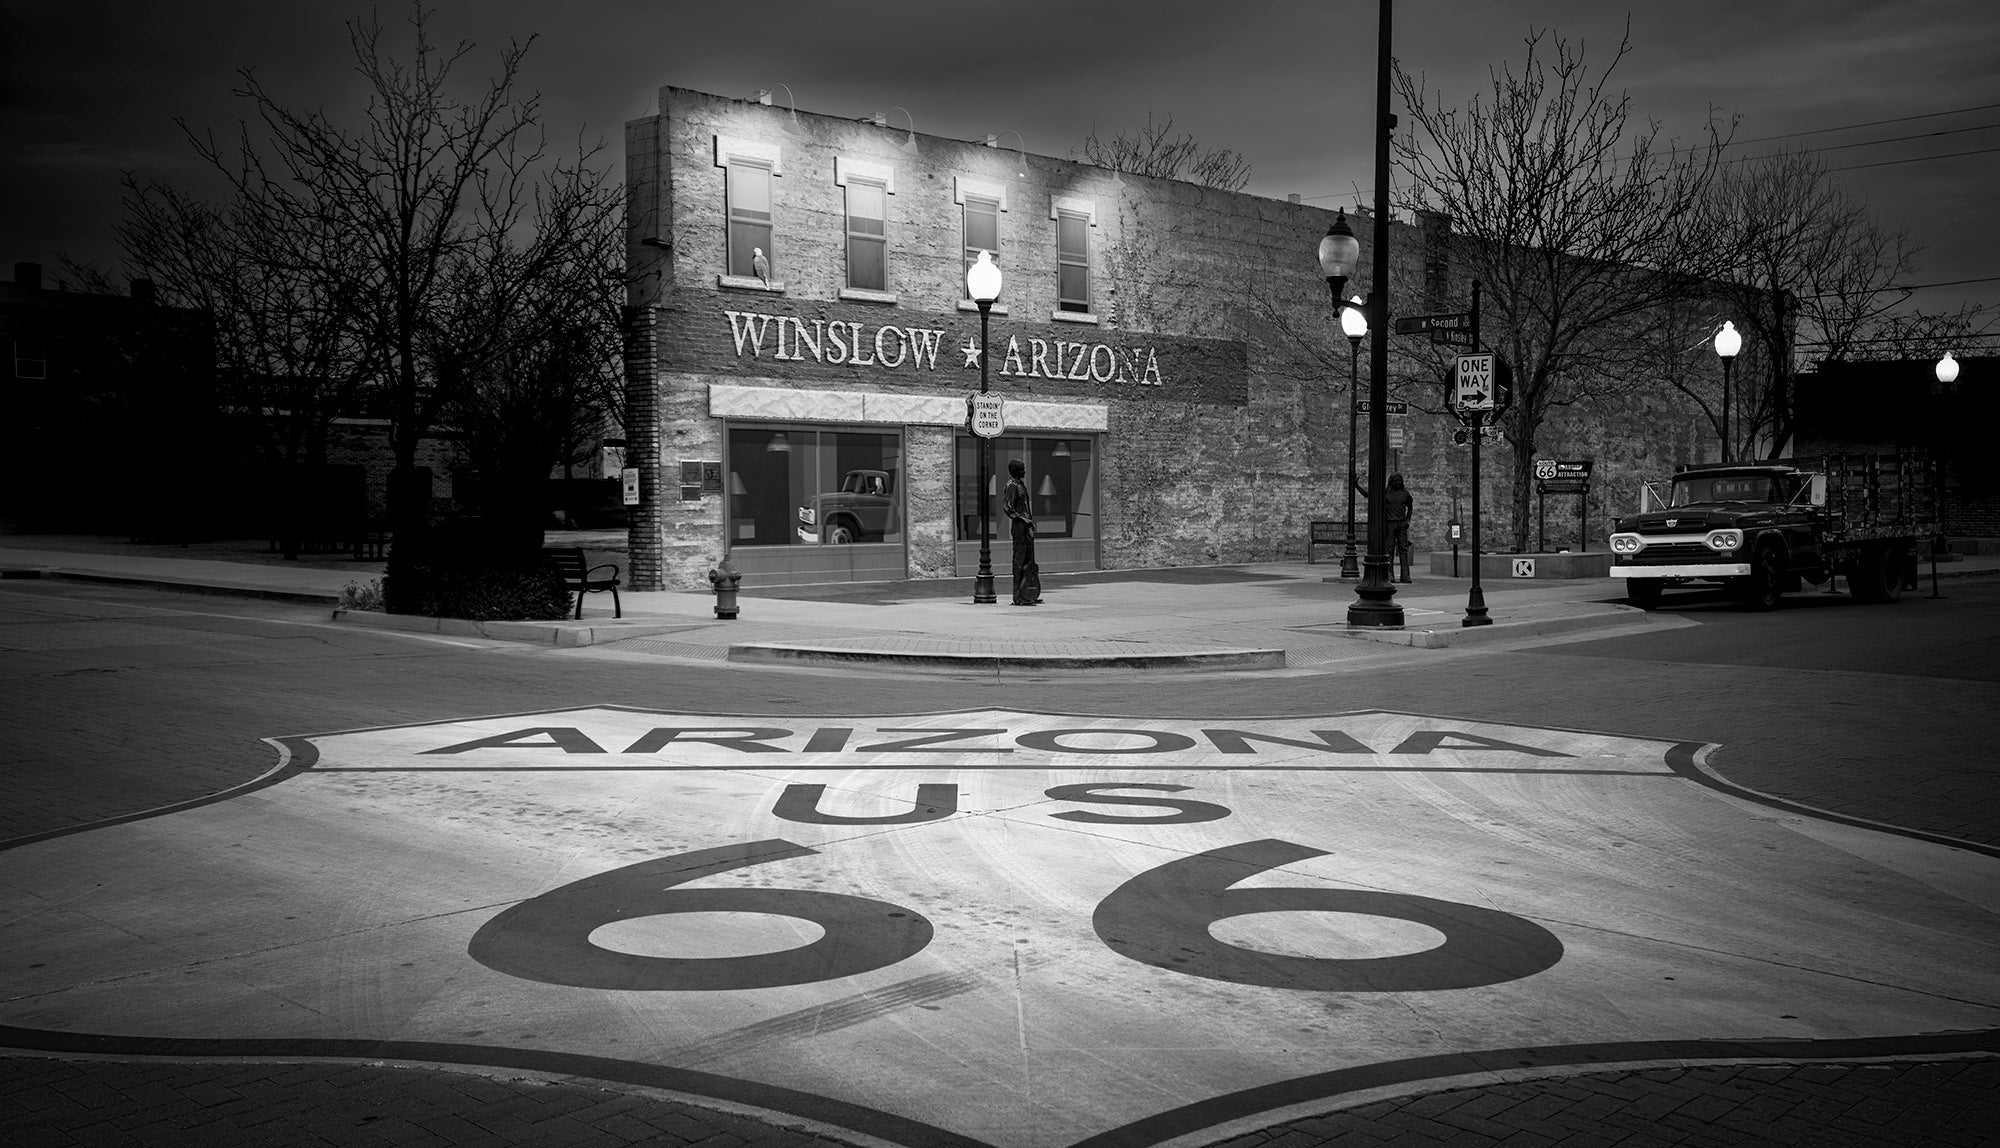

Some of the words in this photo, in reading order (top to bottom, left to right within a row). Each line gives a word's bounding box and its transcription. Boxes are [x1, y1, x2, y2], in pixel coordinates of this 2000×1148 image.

[1431, 317, 1459, 328] Second
[724, 310, 946, 370] WINSLOW
[999, 333, 1163, 386] ARIZONA
[1461, 359, 1489, 373] ONE
[1460, 374, 1489, 388] WAY
[976, 402, 1000, 410] STANDIN'
[979, 411, 987, 419] ON
[988, 412, 997, 420] THE
[1539, 466, 1554, 478] 66
[415, 727, 1579, 758] ARIZONA
